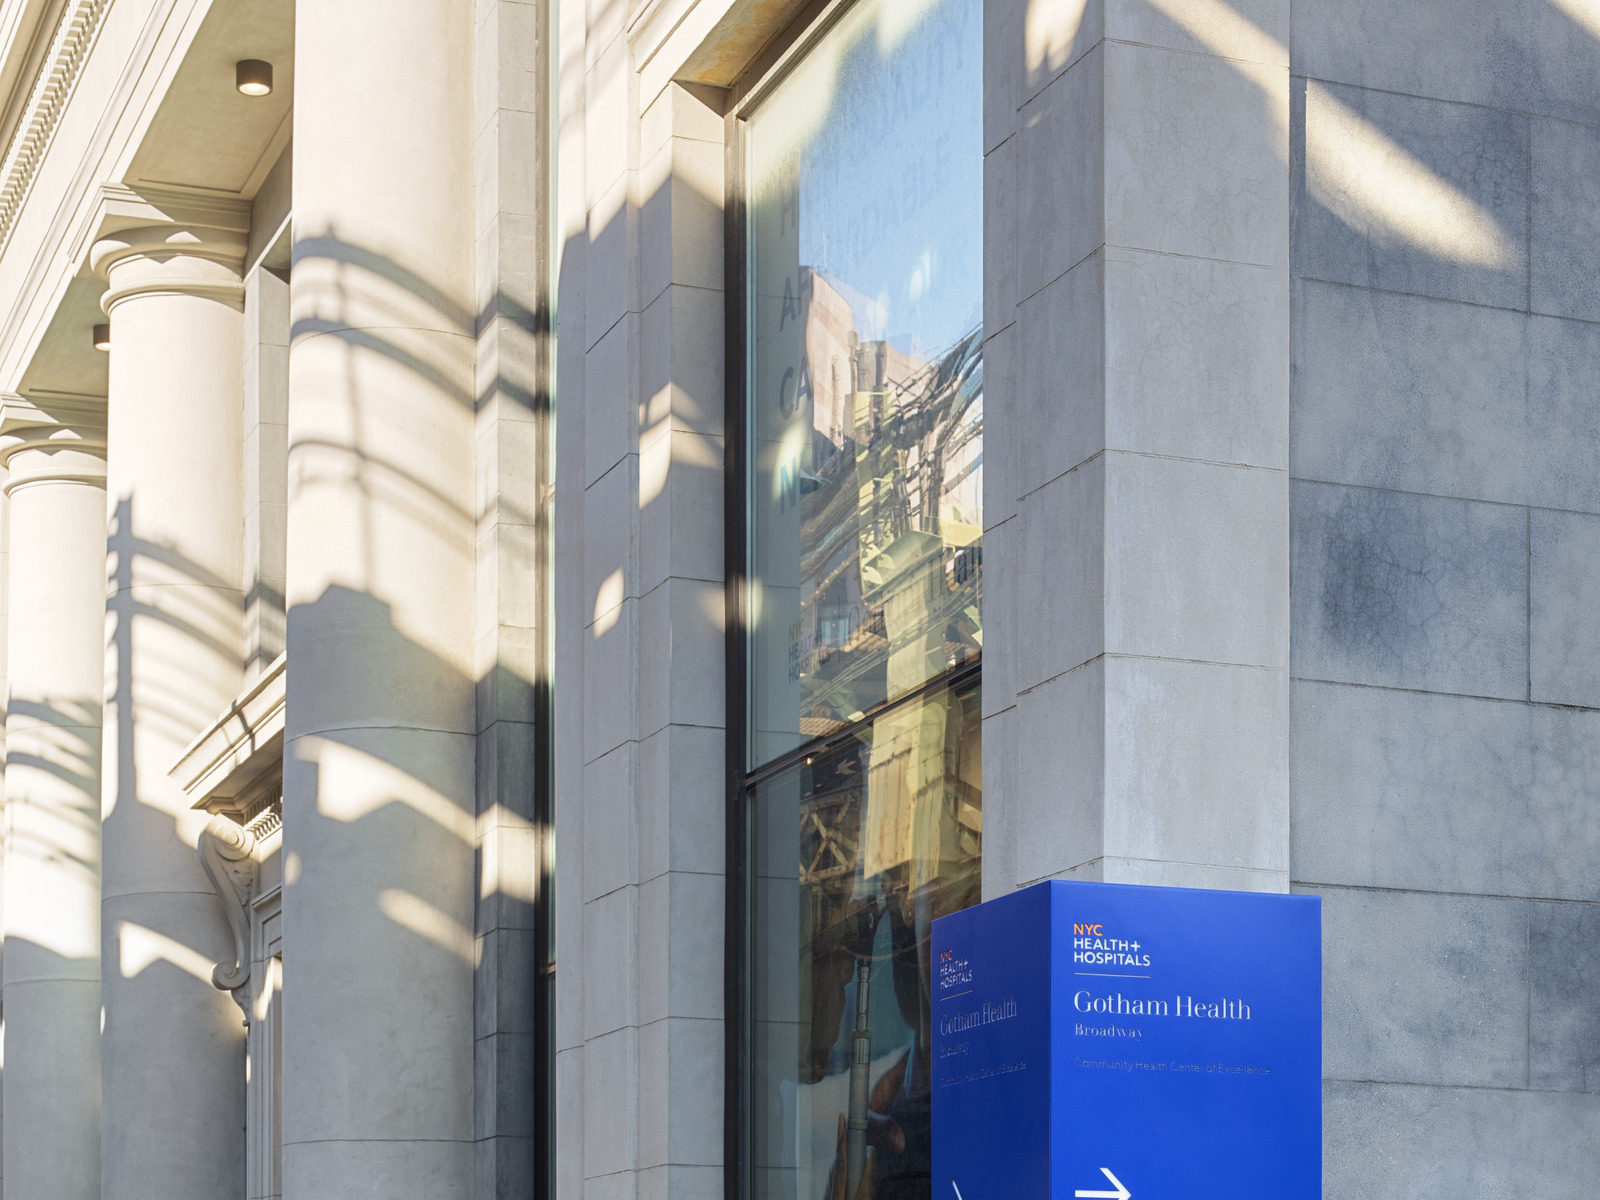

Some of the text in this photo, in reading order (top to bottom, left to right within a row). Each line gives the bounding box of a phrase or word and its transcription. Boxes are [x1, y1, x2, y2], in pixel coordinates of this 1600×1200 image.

[789, 618, 804, 643] NYC
[1074, 923, 1103, 937] NYC
[1074, 937, 1141, 952] HEALTH+
[940, 949, 952, 963] NYC
[1074, 951, 1151, 967] HOSPITALS
[940, 957, 968, 976] HEALTH+
[940, 969, 973, 990] HOSPITALS
[1073, 990, 1252, 1020] Gotham Health
[940, 995, 1017, 1035] Gotham Health
[1074, 1022, 1144, 1041] Broadway
[1074, 1057, 1272, 1076] Community Health Center of Excellence
